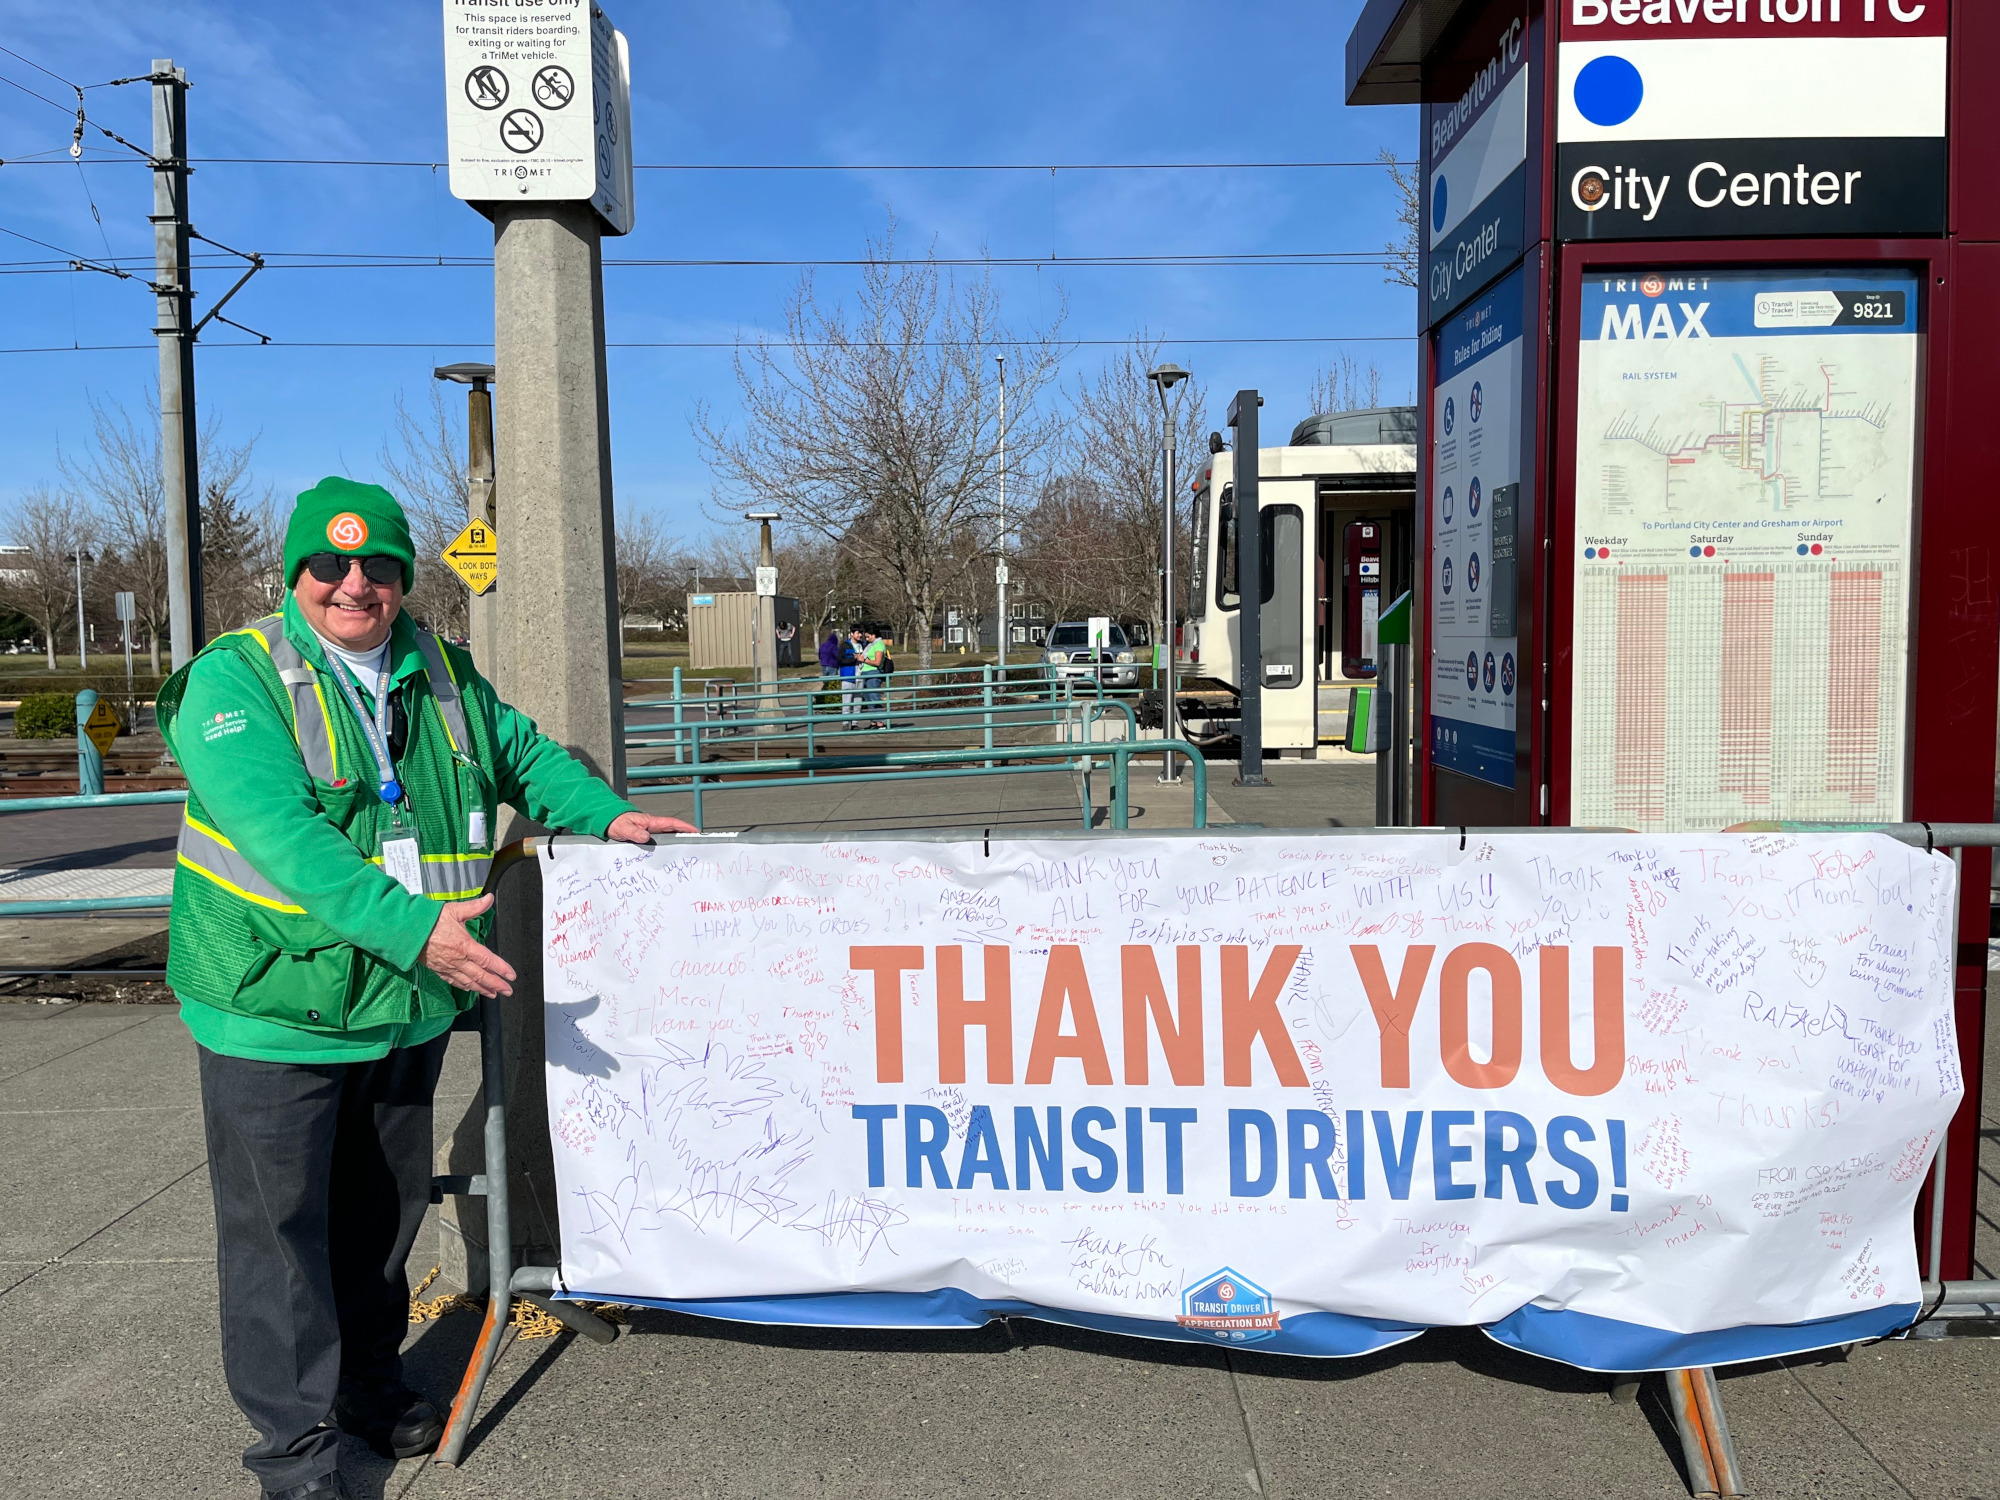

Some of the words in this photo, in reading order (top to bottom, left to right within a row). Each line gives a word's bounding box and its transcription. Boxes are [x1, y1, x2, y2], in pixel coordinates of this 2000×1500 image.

[465, 13, 485, 22] This
[489, 14, 517, 24] space
[520, 14, 528, 22] is
[531, 13, 571, 22] reserved
[1572, 0, 1841, 26] Beaverton
[456, 25, 469, 34] for
[472, 26, 503, 35] transit
[506, 26, 533, 35] riders
[537, 25, 580, 35] boarding,
[468, 39, 501, 49] exiting
[504, 40, 514, 48] or
[517, 39, 550, 49] waiting
[553, 38, 566, 47] for
[481, 52, 487, 60] a
[489, 51, 518, 60] TriMet
[522, 51, 557, 60] vehicle.
[1432, 56, 1497, 159] Beaverton
[1500, 16, 1521, 76] TC
[1571, 165, 1670, 222] City
[1688, 161, 1862, 208] Center
[1430, 257, 1452, 302] City
[1455, 218, 1500, 282] Center
[1600, 302, 1711, 341] MAX
[1853, 302, 1894, 318] 9821
[1481, 324, 1503, 348] Riding
[1622, 372, 1643, 381] RAIL
[1644, 371, 1677, 380] SYSTEM
[1642, 522, 1652, 530] To
[1654, 521, 1692, 530] Portland
[1693, 521, 1710, 531] City
[1712, 520, 1740, 529] Center
[1743, 519, 1759, 528] and
[1761, 519, 1799, 528] Gresham
[1802, 519, 1811, 527] or
[1812, 518, 1843, 528] Airport
[1585, 536, 1628, 546] Weekday
[1690, 535, 1734, 544] Saturday
[1797, 533, 1833, 542] Sunday
[1013, 855, 1108, 896] THANK
[1526, 855, 1604, 892] Thank
[1680, 848, 1783, 887] Thank
[1051, 892, 1100, 927] ALL
[1119, 888, 1160, 915] FOR
[1353, 875, 1413, 909] WITH
[1789, 876, 1864, 908] Thank
[1667, 914, 1711, 966] Thank
[624, 995, 700, 1036] Thank
[849, 944, 1310, 1087] THANK
[1349, 942, 1626, 1096] YOU
[852, 1104, 1198, 1195] TRANSIT
[1228, 1108, 1629, 1213] DRIVERS!
[1758, 1167, 1797, 1187] FROM
[1194, 1302, 1228, 1313] TRANSIT
[1231, 1303, 1260, 1313] DRIVER
[1185, 1318, 1252, 1328] APPRECIATION
[1255, 1317, 1273, 1327] DAY
